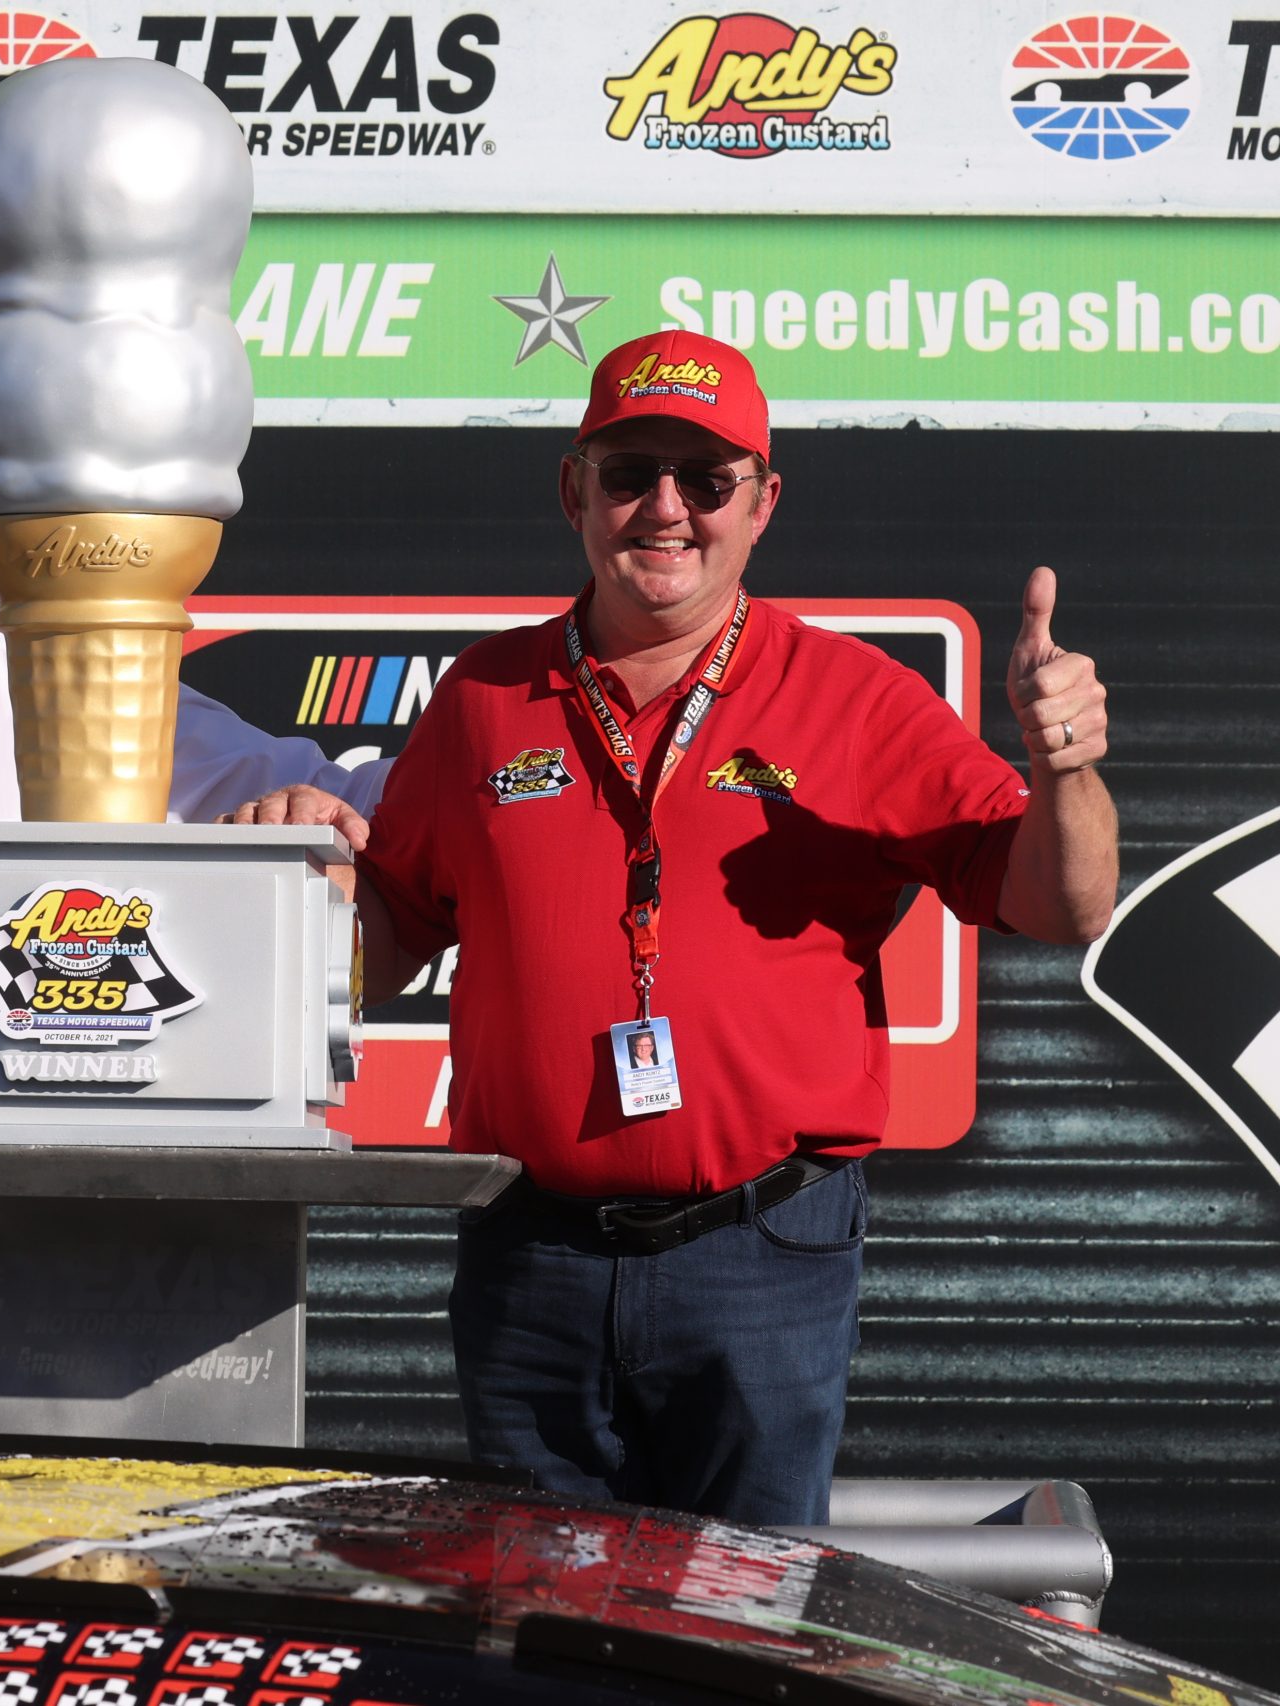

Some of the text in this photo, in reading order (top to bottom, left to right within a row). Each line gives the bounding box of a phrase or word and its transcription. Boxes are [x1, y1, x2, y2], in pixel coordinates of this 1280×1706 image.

[138, 14, 500, 114] TEXAS
[604, 14, 898, 141] Andy's
[282, 123, 485, 156] SPEEDWAY
[644, 114, 890, 151] Frozen Custard
[236, 262, 436, 358] ANE
[618, 353, 721, 398] Andy's
[630, 383, 717, 405] Frozen Custard
[26, 525, 154, 579] Andy's
[703, 666, 724, 684] NO
[732, 590, 749, 629] TEXAS
[577, 662, 592, 686] NO
[603, 719, 633, 757] TEXAS
[683, 684, 710, 723] TEXAS
[507, 750, 562, 775] Andy's
[706, 757, 798, 790] Andy's
[511, 779, 549, 795] 335
[717, 781, 792, 804] Frozen Custard
[10, 889, 153, 950] Andy's
[29, 938, 149, 957] Frozen Custard
[60, 961, 113, 978] ANNIVERSARY
[31, 979, 127, 1011] 335
[36, 1016, 150, 1028] TEXAS MOTOR SPEEDWAY
[44, 1033, 81, 1041] OCTOBER
[95, 1034, 114, 1042] 2021
[1, 1053, 155, 1080] WINNER
[644, 1092, 671, 1103] TEXAS
